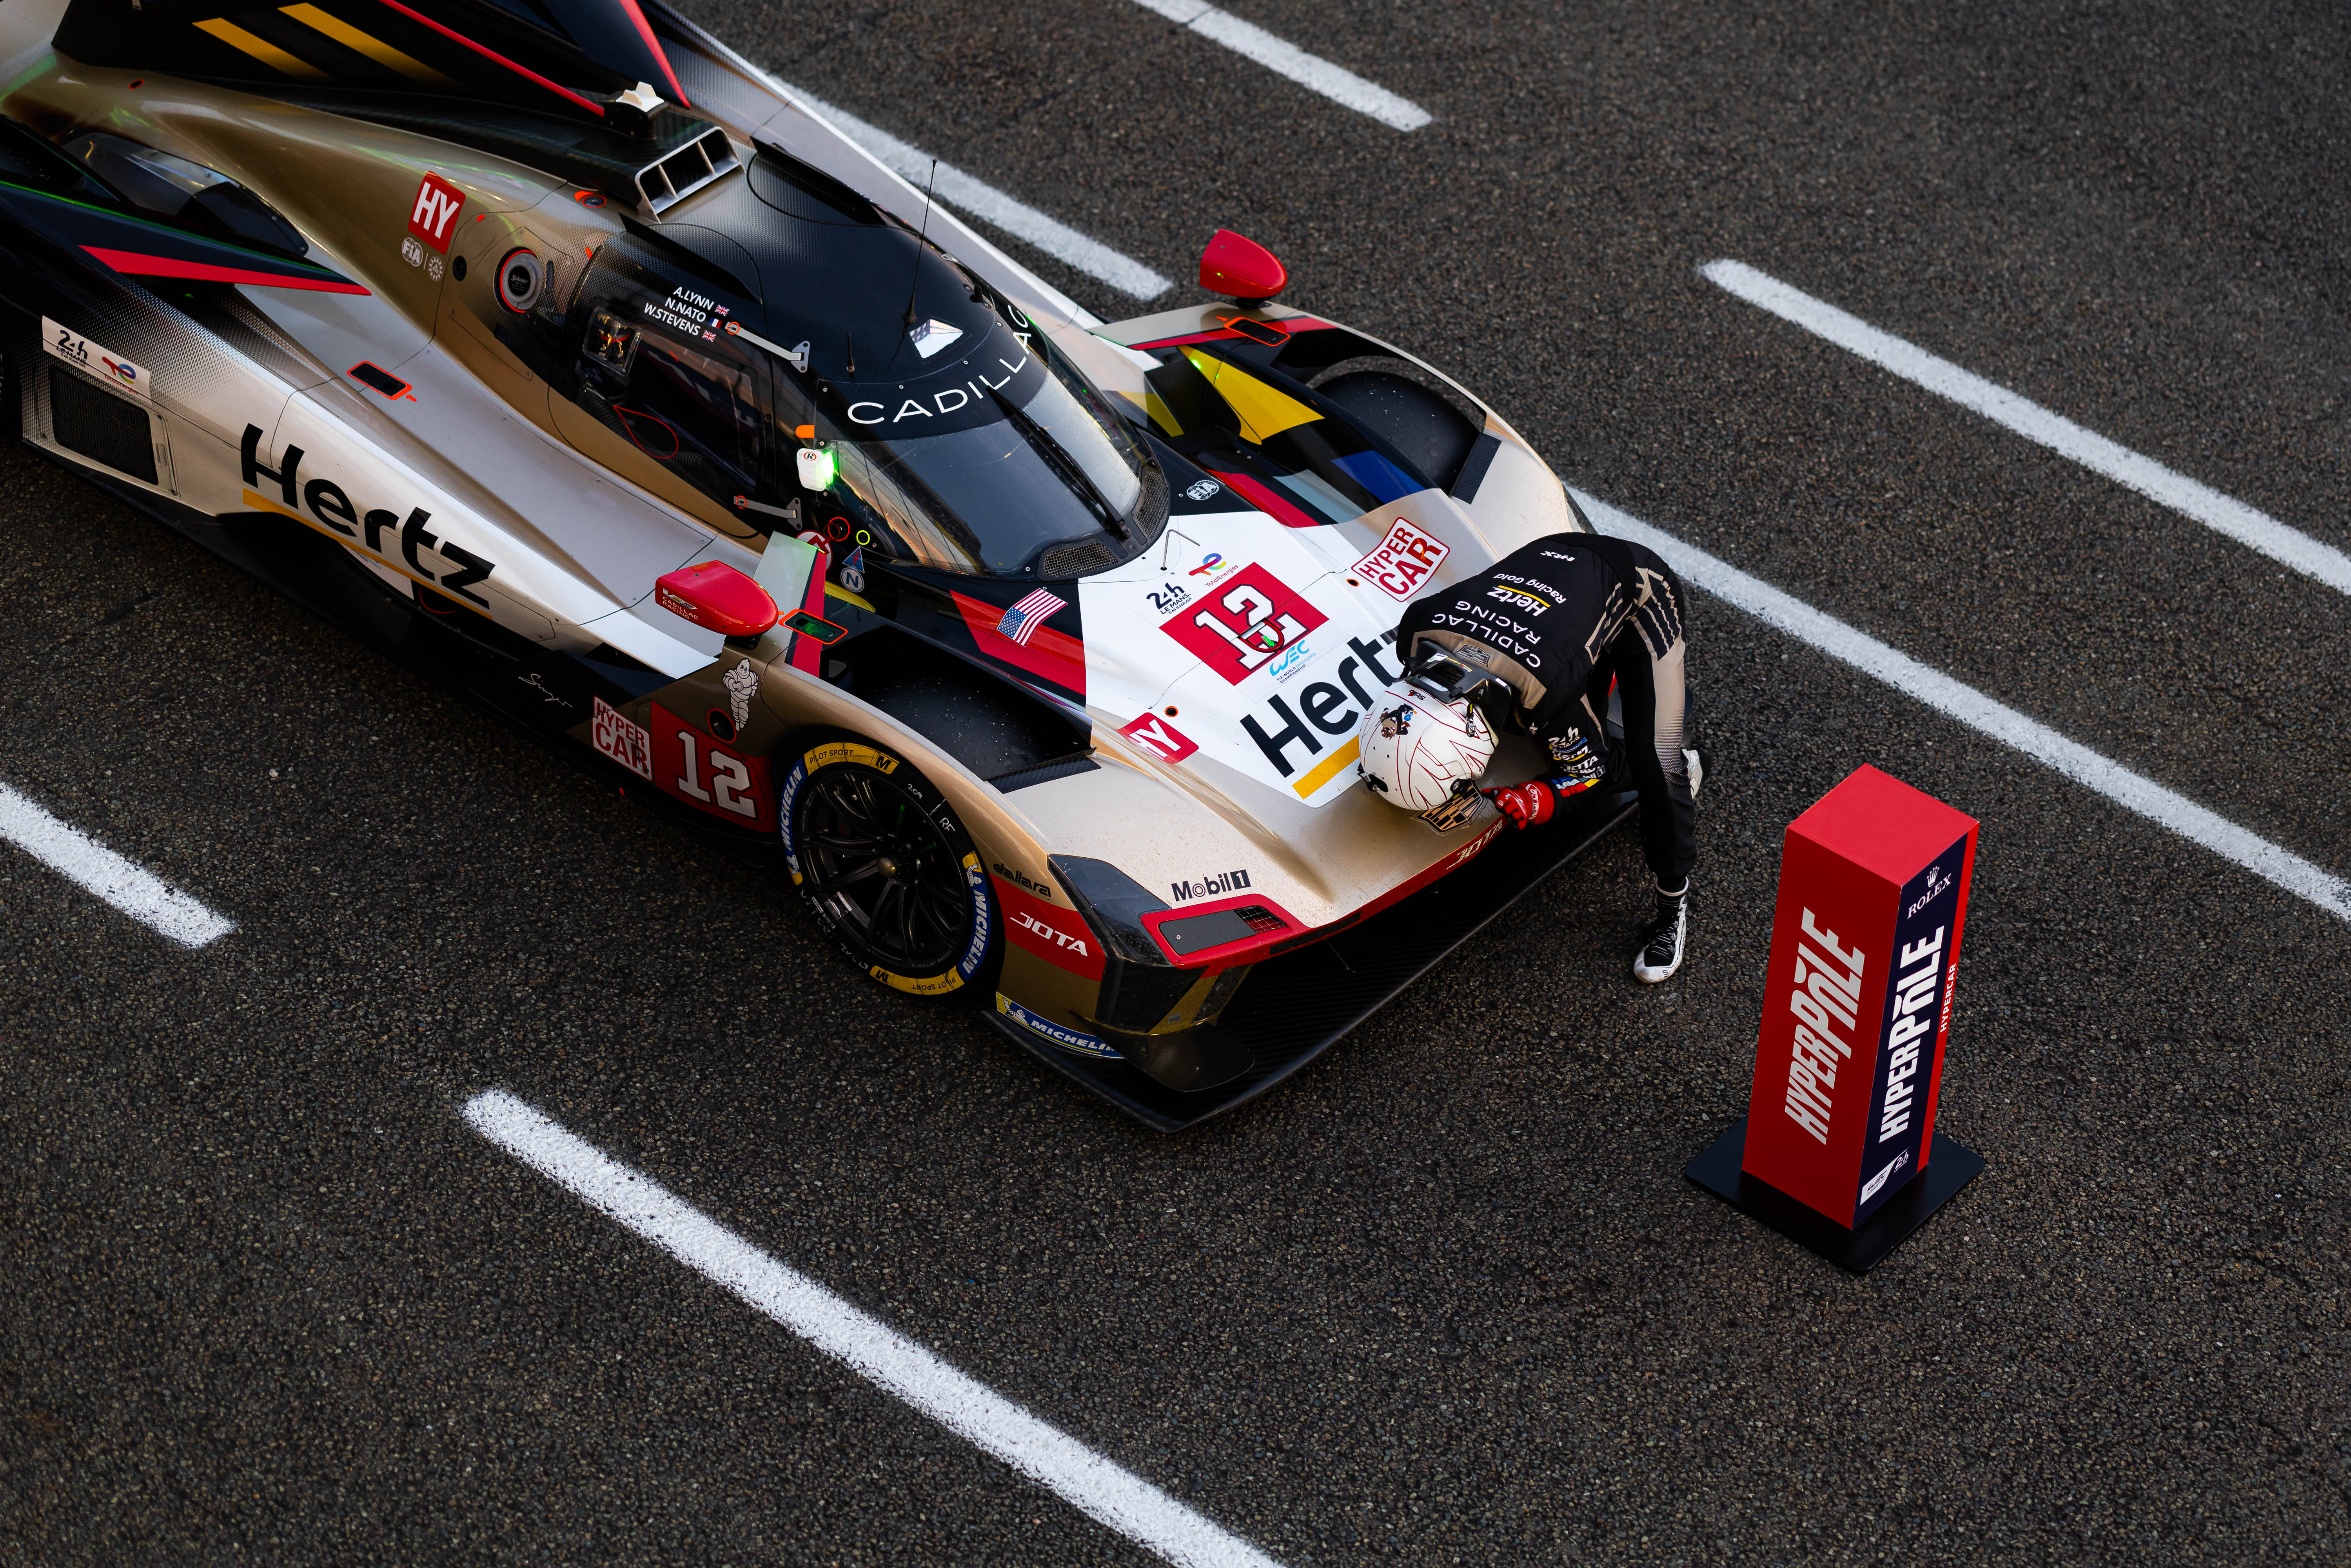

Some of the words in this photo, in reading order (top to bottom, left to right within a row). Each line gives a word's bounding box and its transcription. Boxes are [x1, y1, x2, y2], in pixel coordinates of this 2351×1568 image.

[413, 181, 459, 239] HY
[402, 240, 420, 264] FIA
[664, 297, 706, 322] N.NATO
[673, 287, 714, 310] A.LYNN
[644, 302, 701, 336] W.STEVENS
[58, 330, 88, 359] 24h
[847, 305, 1031, 425] CADILLAC
[104, 374, 138, 395] TotalEnergies
[1188, 482, 1217, 499] FIA
[241, 423, 496, 610] Hertz
[1358, 527, 1414, 579] HYPER
[1378, 537, 1443, 594] CAR
[846, 572, 859, 589] N
[1205, 565, 1238, 587] TotalEnergies
[1493, 573, 1524, 584] Gold
[1146, 583, 1185, 610] 24h
[1160, 606, 1170, 614] LE
[1169, 593, 1189, 608] MANS
[1487, 587, 1547, 617] Hertz
[1525, 579, 1567, 604] Racing
[663, 597, 698, 620] CADILLAC
[663, 601, 690, 619] RACING
[1455, 601, 1541, 644] RACING
[1193, 584, 1310, 672] 12
[1432, 613, 1541, 668] CADILLAC
[1269, 640, 1309, 676] WEC
[1283, 666, 1296, 677] WORLD
[1295, 652, 1317, 668] ENDURANCE
[1280, 664, 1306, 684] CHAMPIONSHIP
[595, 702, 645, 749] HYPER
[1129, 719, 1181, 757] HY
[595, 722, 649, 775] CAR
[810, 751, 827, 764] PILOT
[875, 755, 891, 771] M
[677, 731, 757, 818] 12
[908, 784, 922, 799] 209
[781, 766, 802, 851] MICHELIN
[939, 817, 956, 831] RF
[993, 863, 1051, 900] dallara
[1171, 873, 1232, 902] Mobil
[1908, 873, 1952, 920] ROLEX
[962, 890, 987, 974] MICHELIN
[1010, 912, 1088, 956] JOTA
[875, 969, 889, 983] M
[938, 976, 956, 989] PILOT
[1940, 962, 1957, 1033] HYPERCAR
